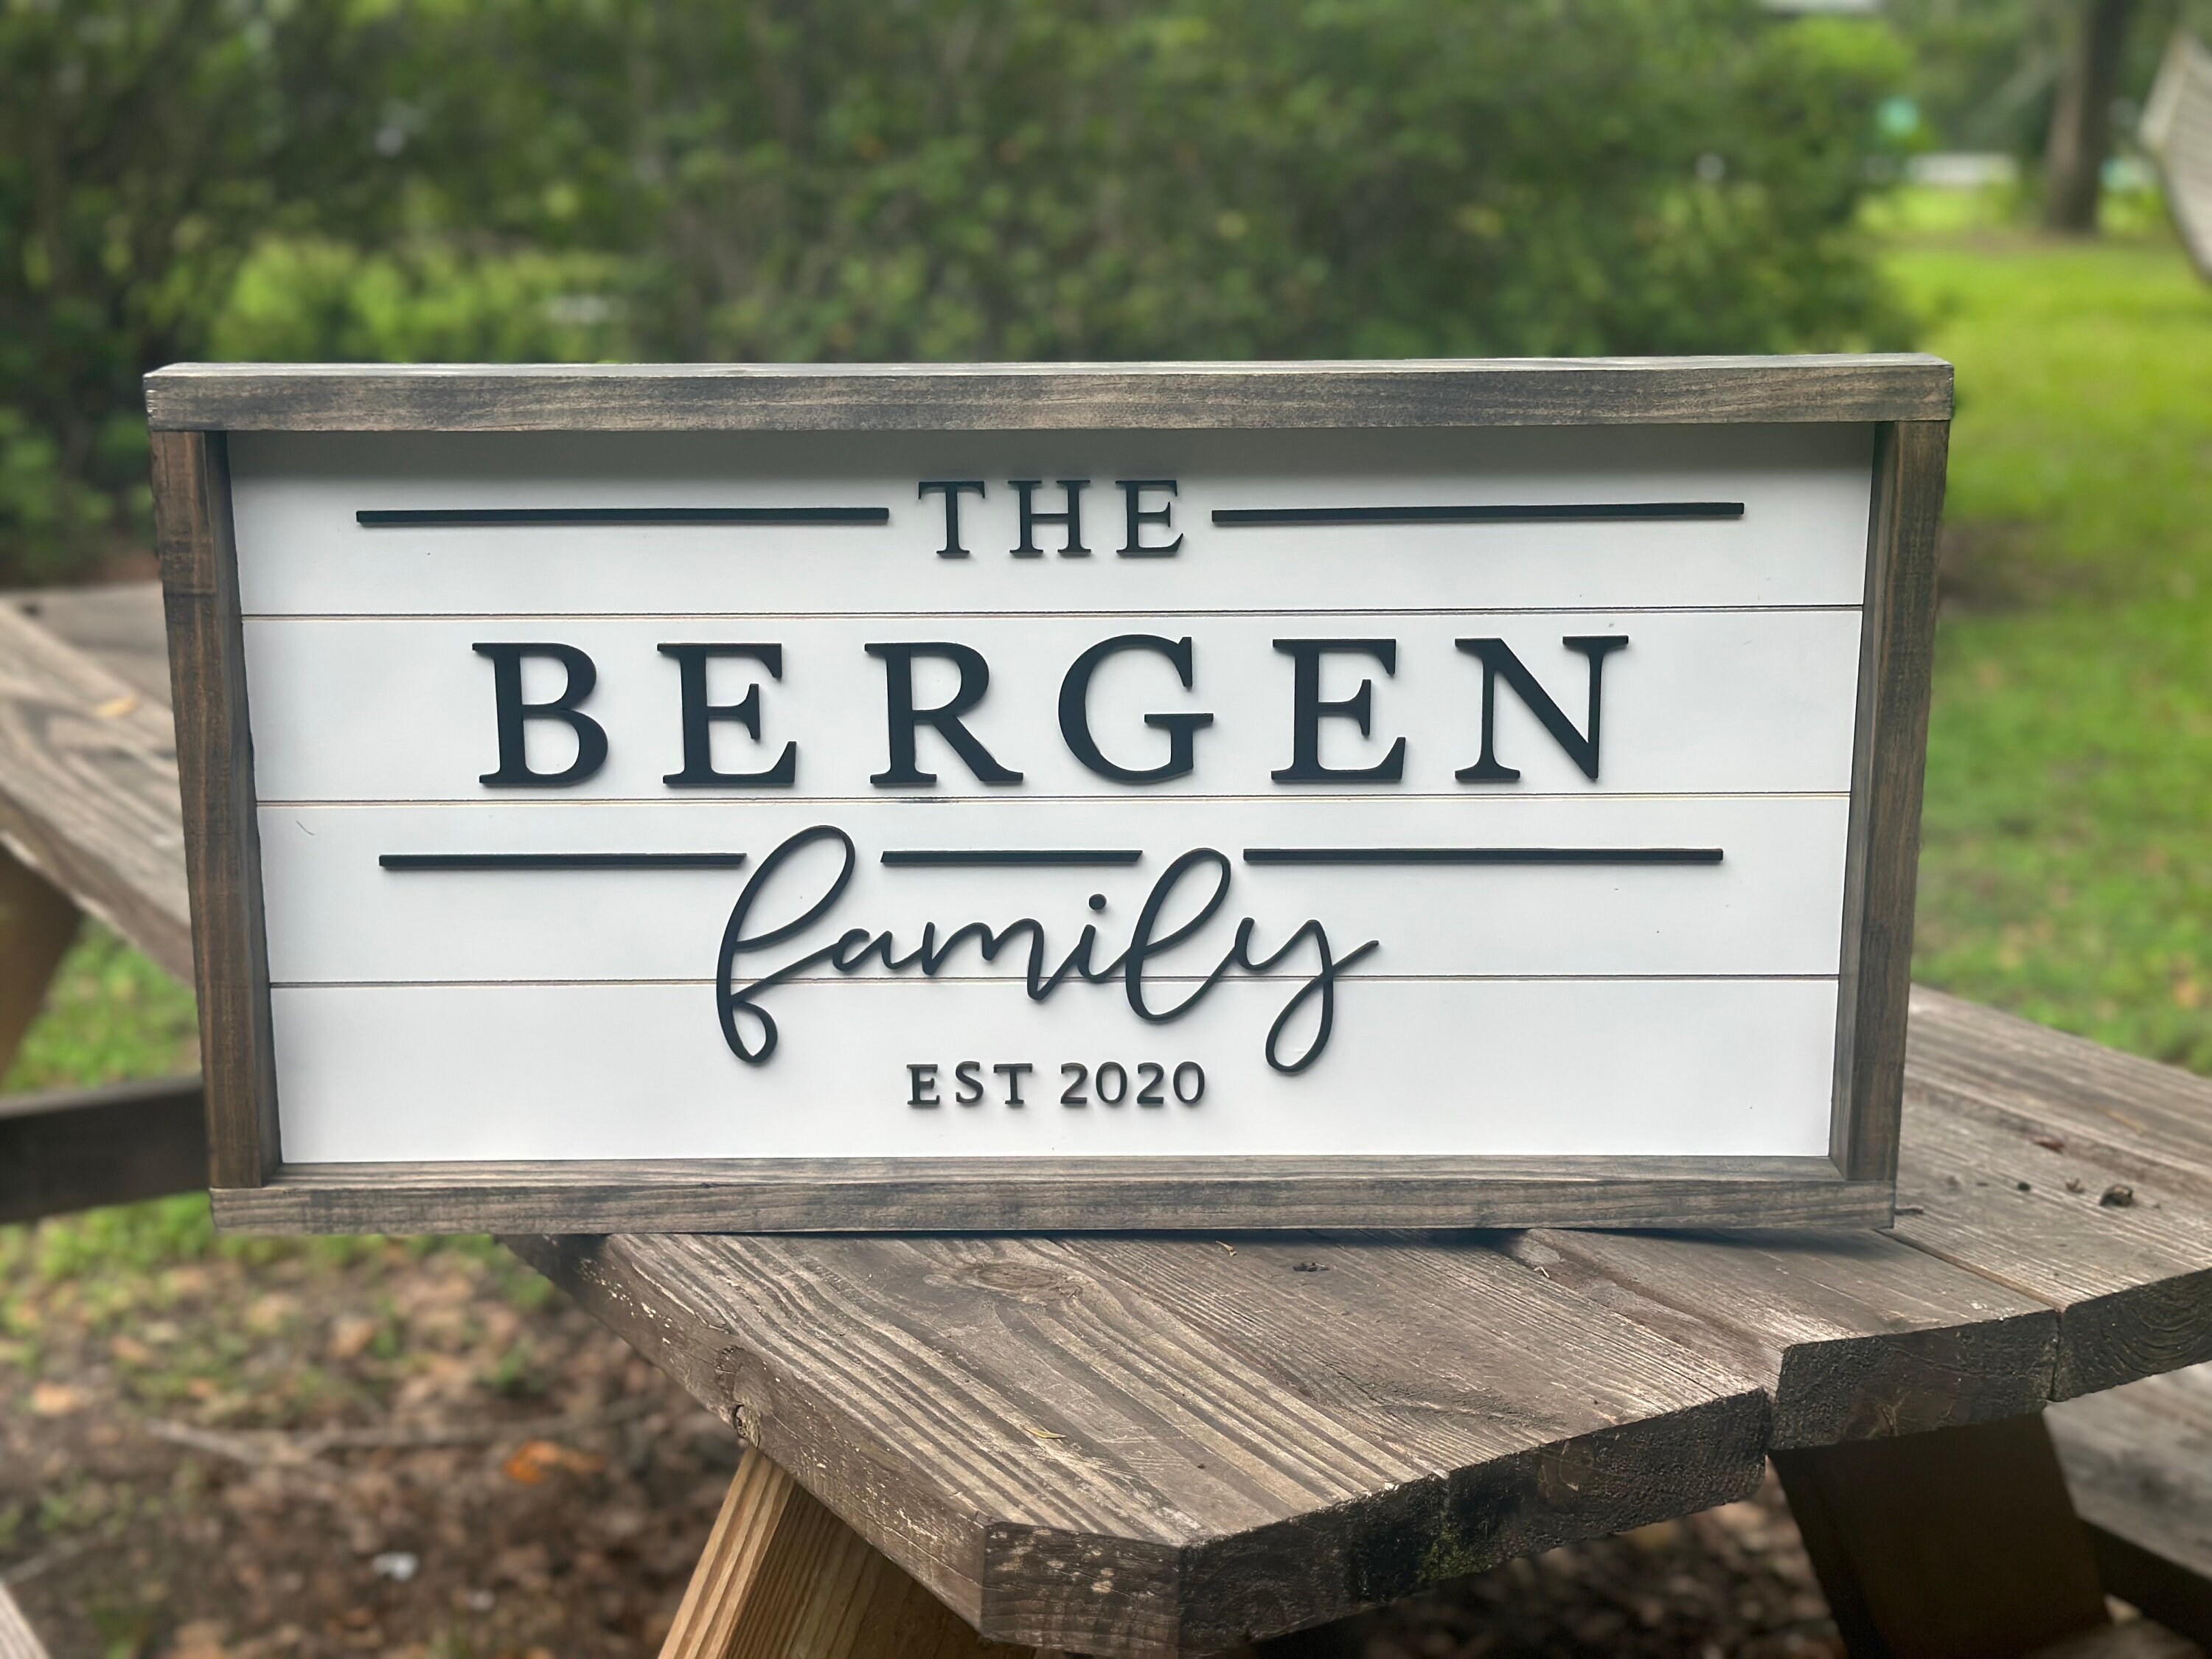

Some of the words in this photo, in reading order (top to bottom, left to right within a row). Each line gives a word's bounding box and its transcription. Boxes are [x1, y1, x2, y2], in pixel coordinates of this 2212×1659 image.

[918, 477, 1184, 559] THE
[472, 633, 1629, 789] BERGEN
[714, 824, 1380, 1074] family
[906, 1062, 1034, 1107] EST
[1060, 1060, 1206, 1106] 2020
